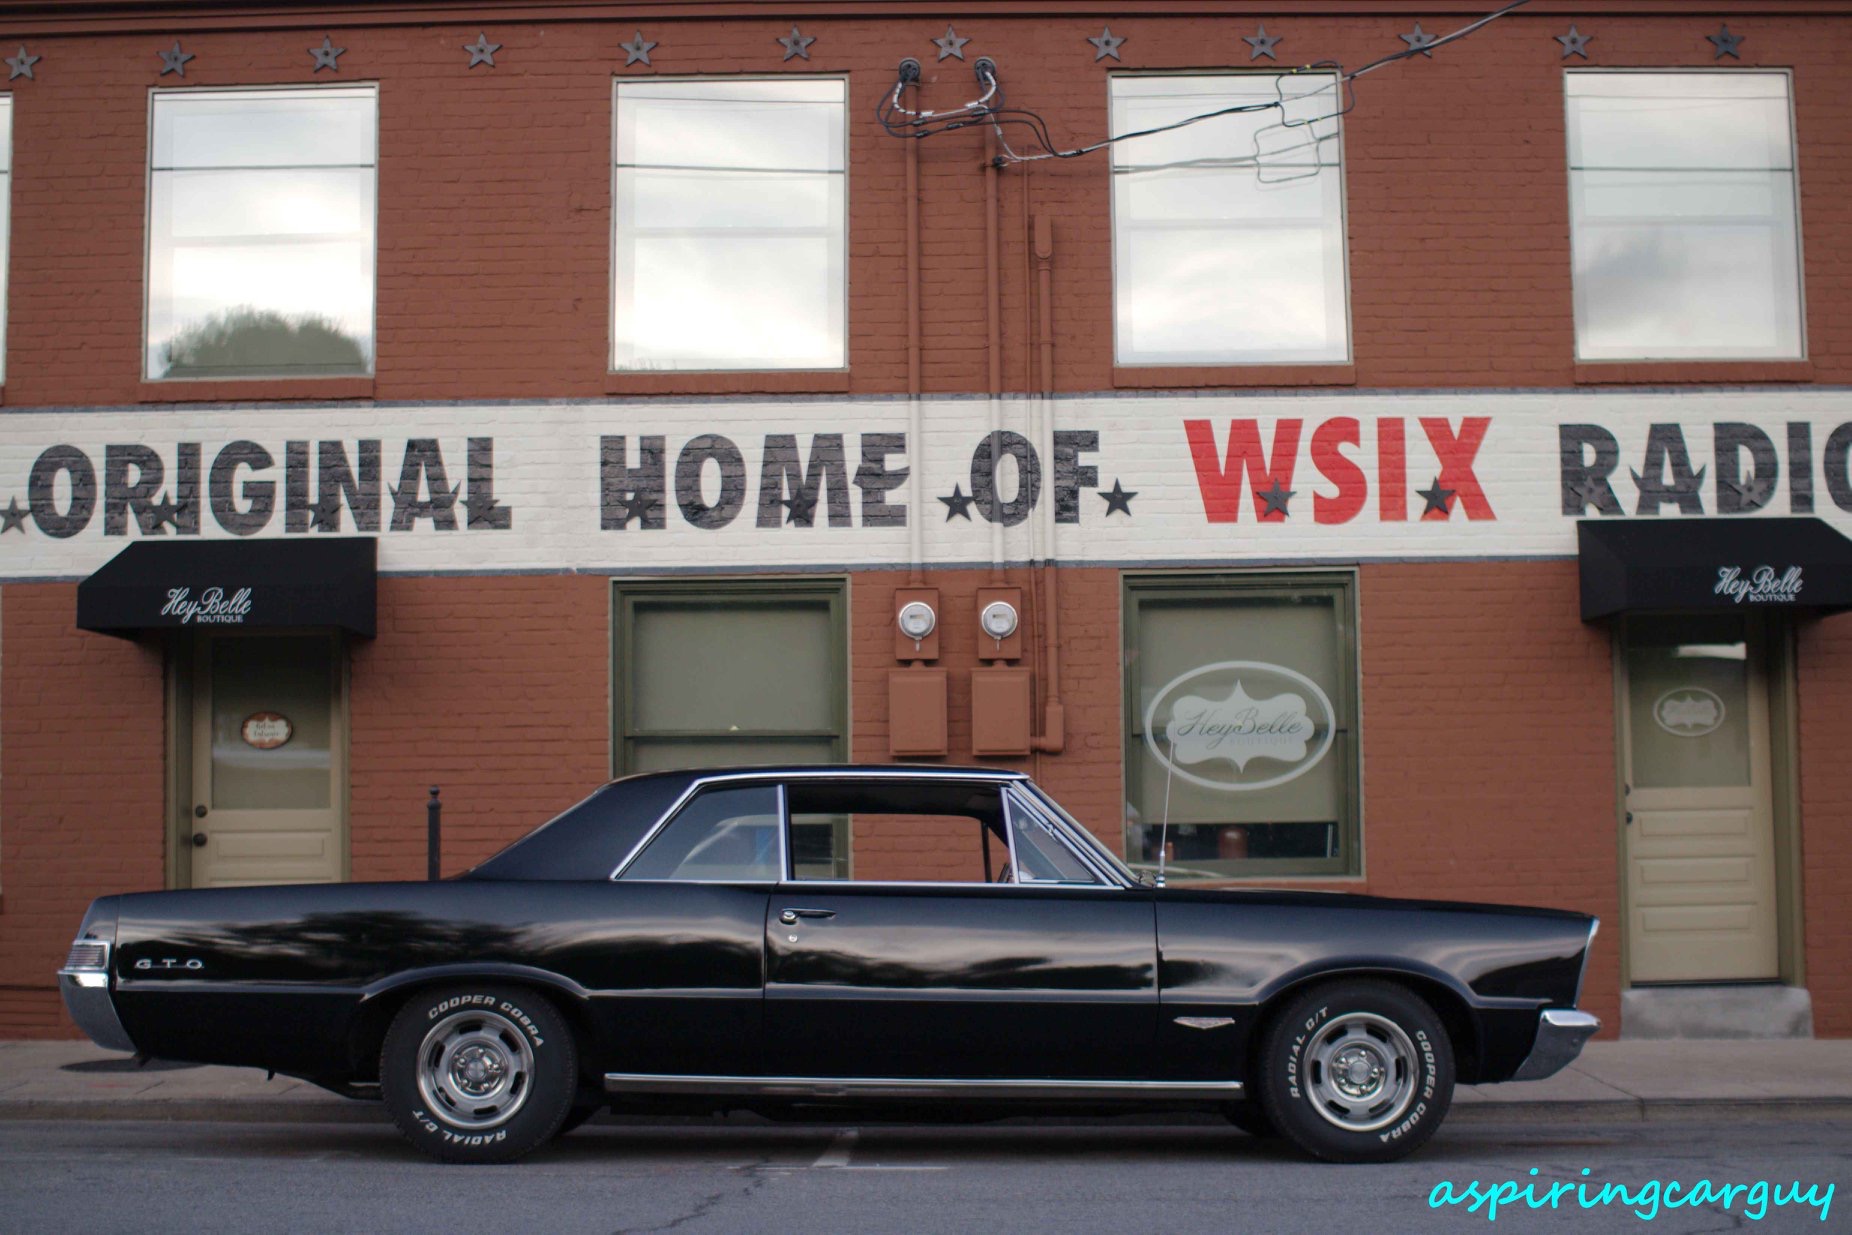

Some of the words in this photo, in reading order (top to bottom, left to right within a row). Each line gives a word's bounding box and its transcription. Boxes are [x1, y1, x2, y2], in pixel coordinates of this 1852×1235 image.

[28, 437, 513, 538] ORIGINAL
[600, 433, 910, 530] HOME
[970, 430, 1099, 527] OF
[1183, 416, 1497, 524] WSIX
[197, 615, 243, 623] BOUTIQUE
[1749, 593, 1796, 602] BOUTIQUE
[428, 995, 496, 1020] COOPER
[500, 1001, 545, 1047] COBRA
[1287, 1034, 1306, 1099] RADIAL
[1415, 1030, 1436, 1099] COOPER
[443, 1129, 507, 1146] RADIAL
[1379, 1102, 1427, 1143] COBRA
